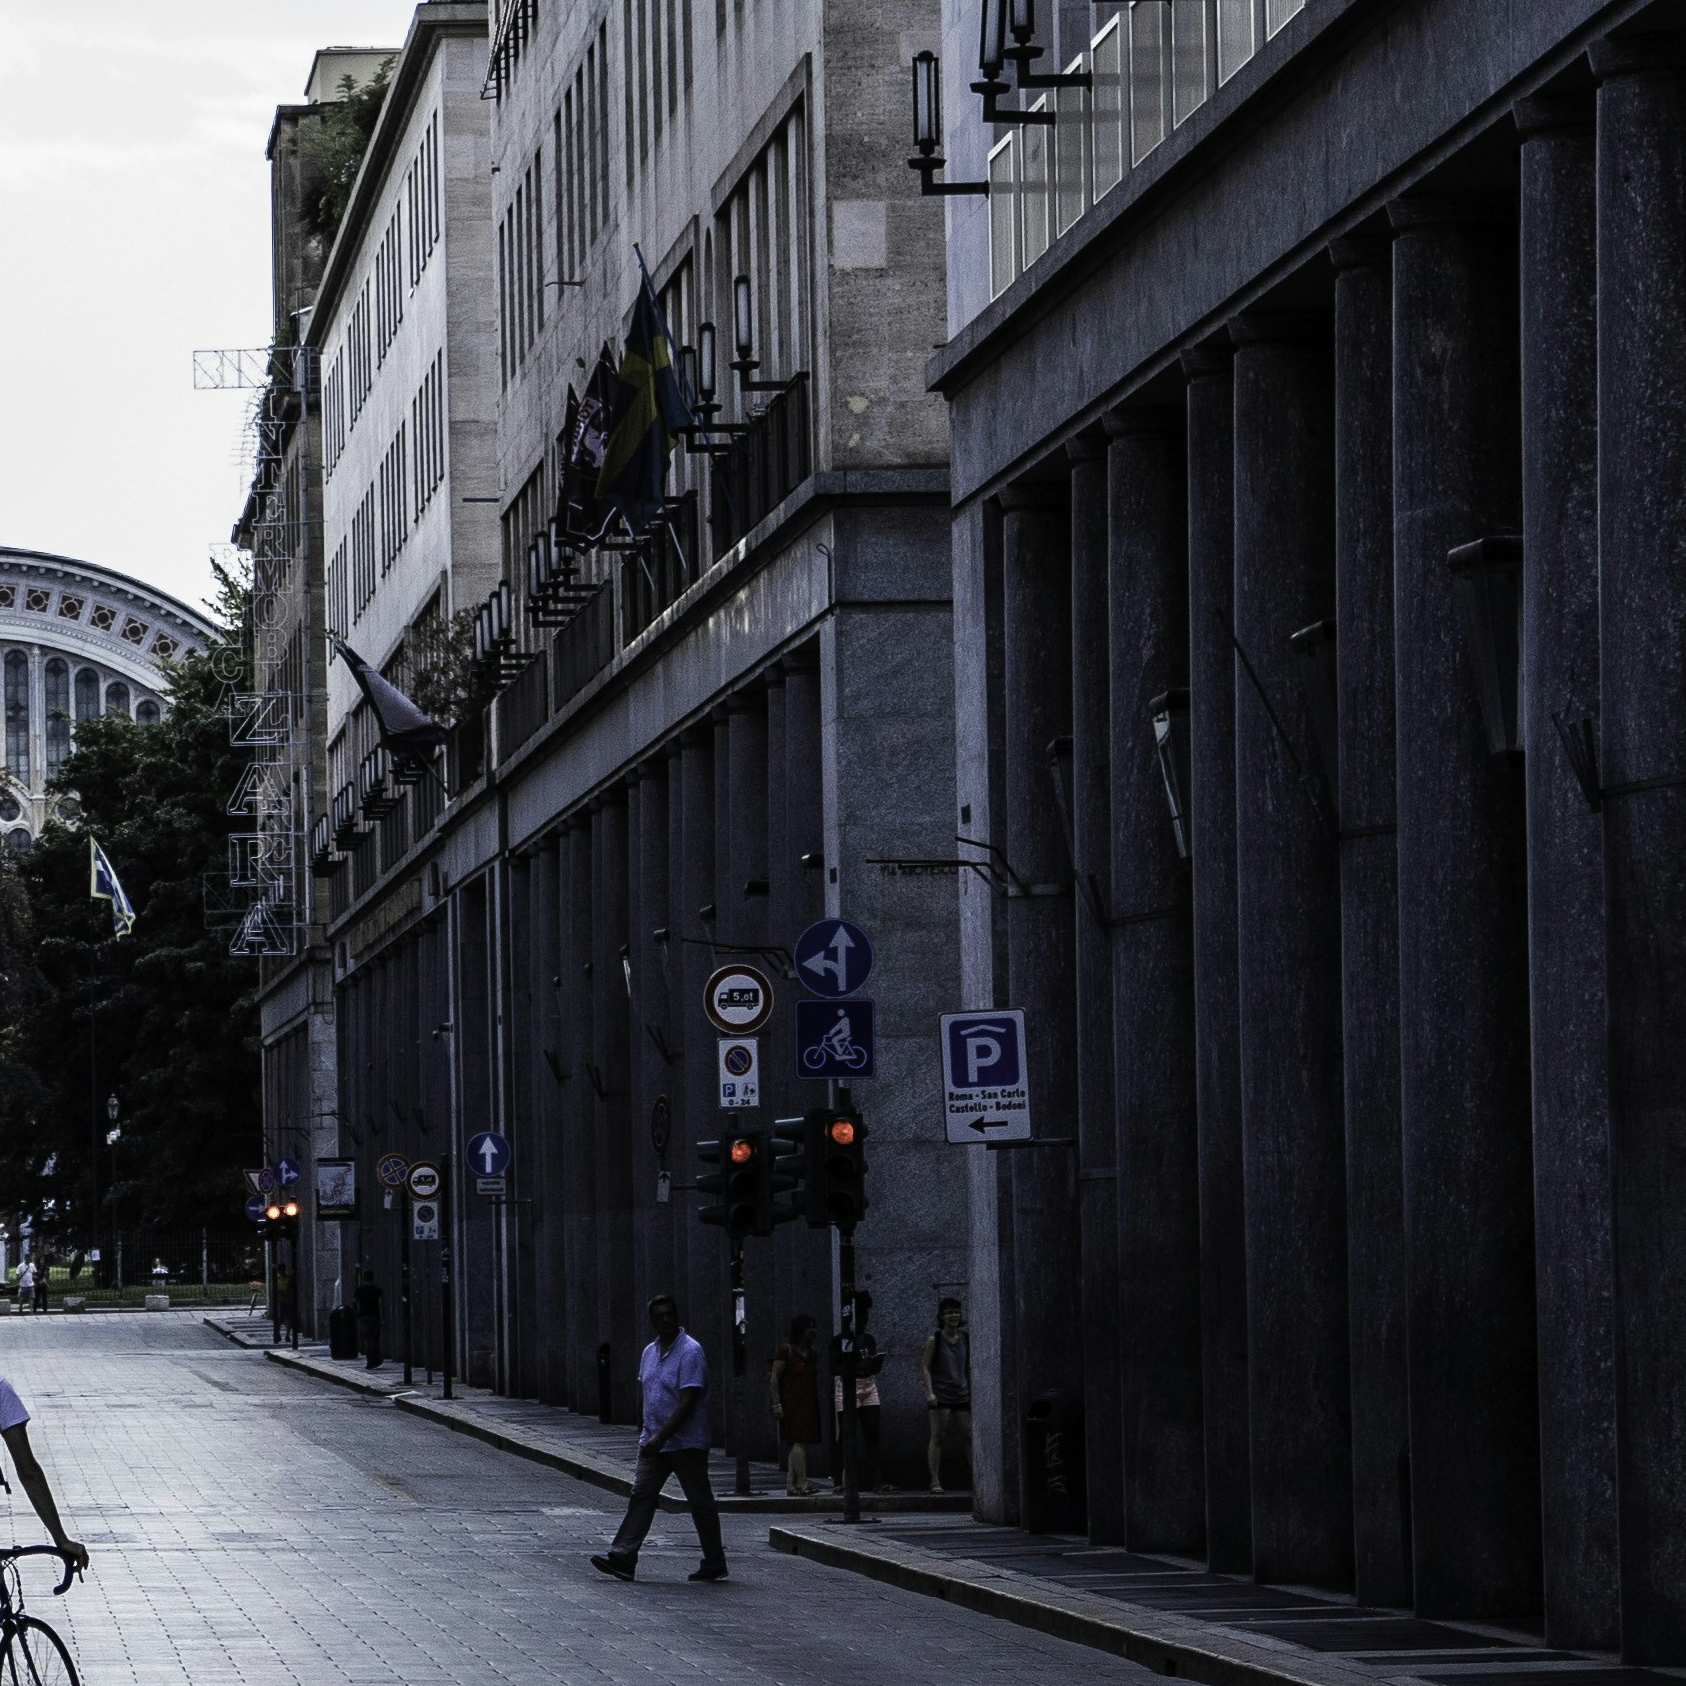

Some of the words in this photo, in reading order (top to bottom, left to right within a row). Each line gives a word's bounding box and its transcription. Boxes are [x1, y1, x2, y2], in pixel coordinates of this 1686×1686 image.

[228, 697, 289, 954] ZARA
[966, 1037, 1002, 1083] P
[948, 1091, 974, 1101] Roma
[980, 1089, 998, 1100] San
[1000, 1088, 1026, 1098] Carlo
[949, 1102, 988, 1113] Castello
[995, 1100, 1026, 1111] Bodoni
